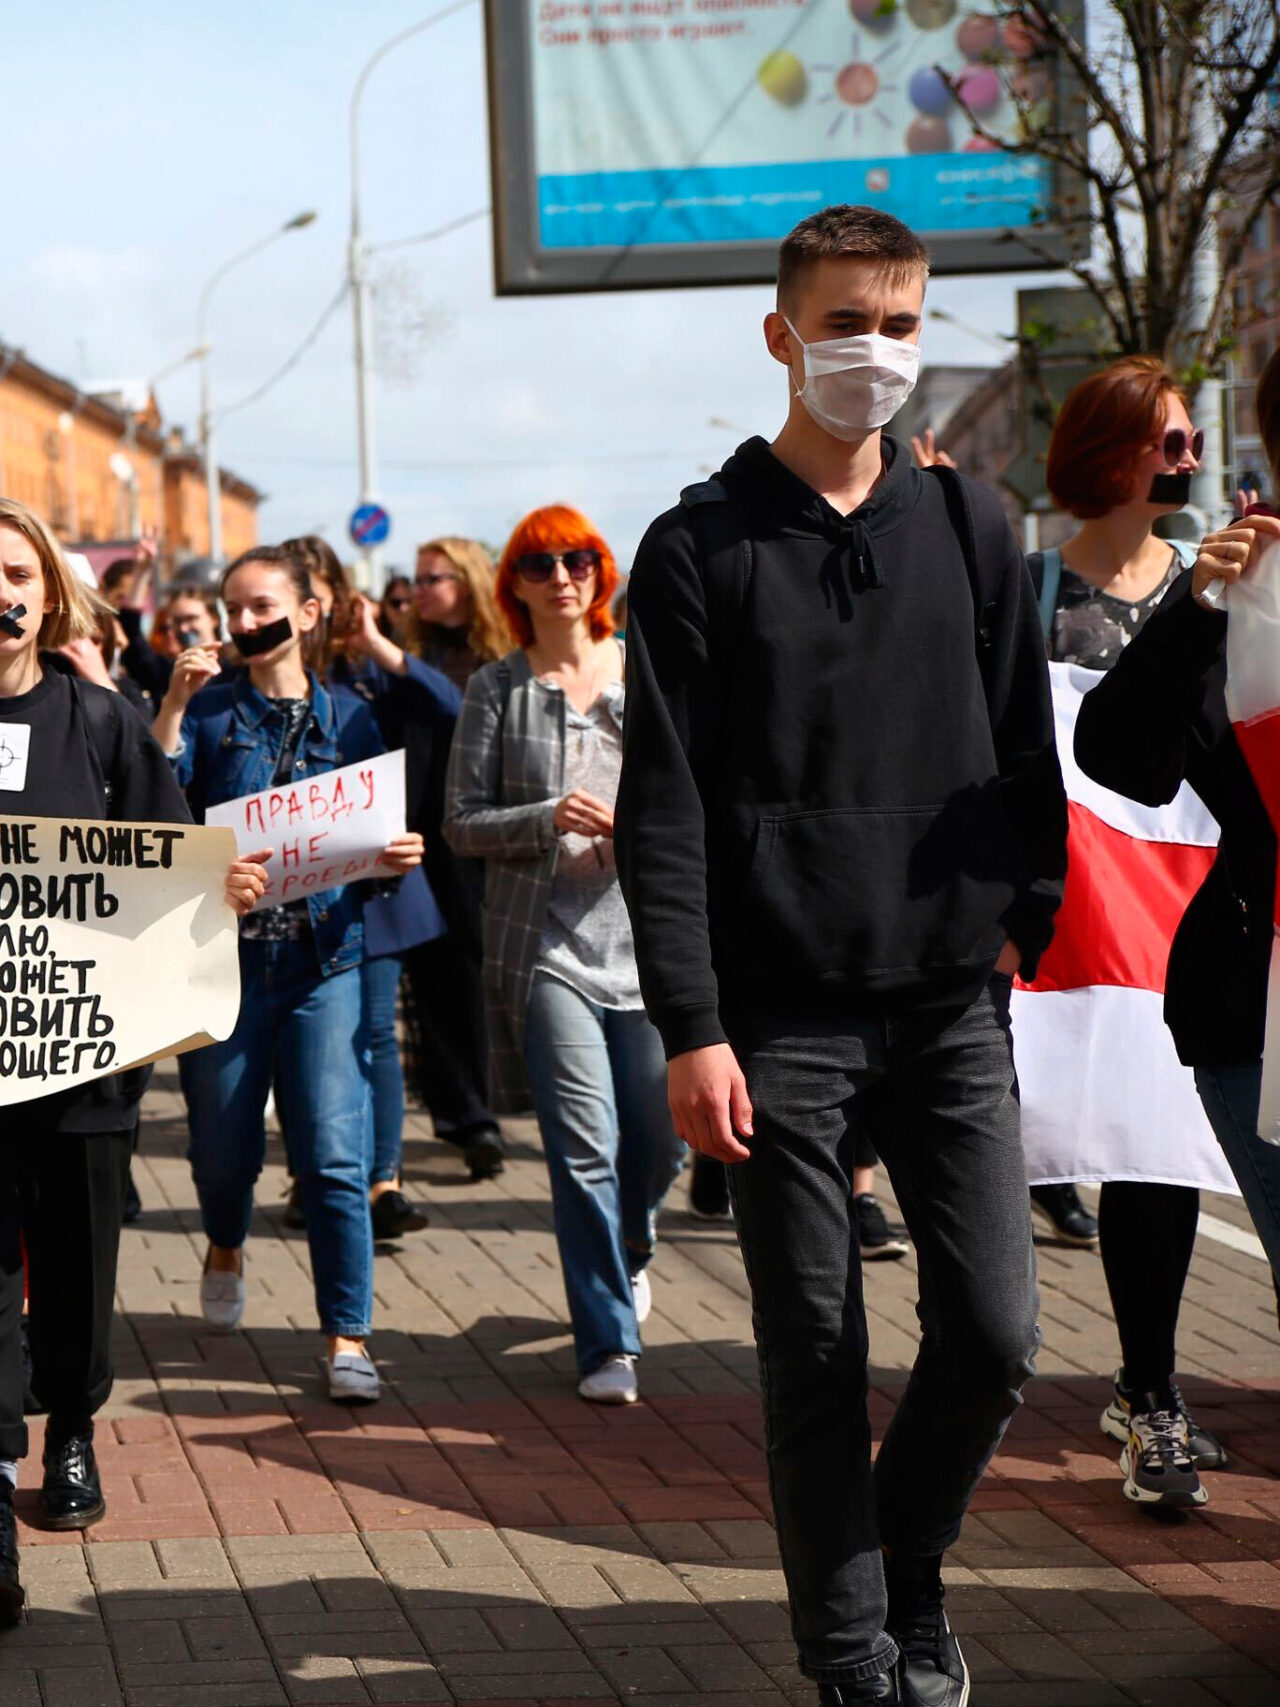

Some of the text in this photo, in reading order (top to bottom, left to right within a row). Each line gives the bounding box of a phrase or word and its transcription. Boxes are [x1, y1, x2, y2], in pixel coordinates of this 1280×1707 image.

[245, 770, 375, 833] ПРАВДУ
[0, 823, 39, 865] НЕ
[59, 824, 185, 869] МОЖЕТ
[282, 832, 329, 869] НЕ
